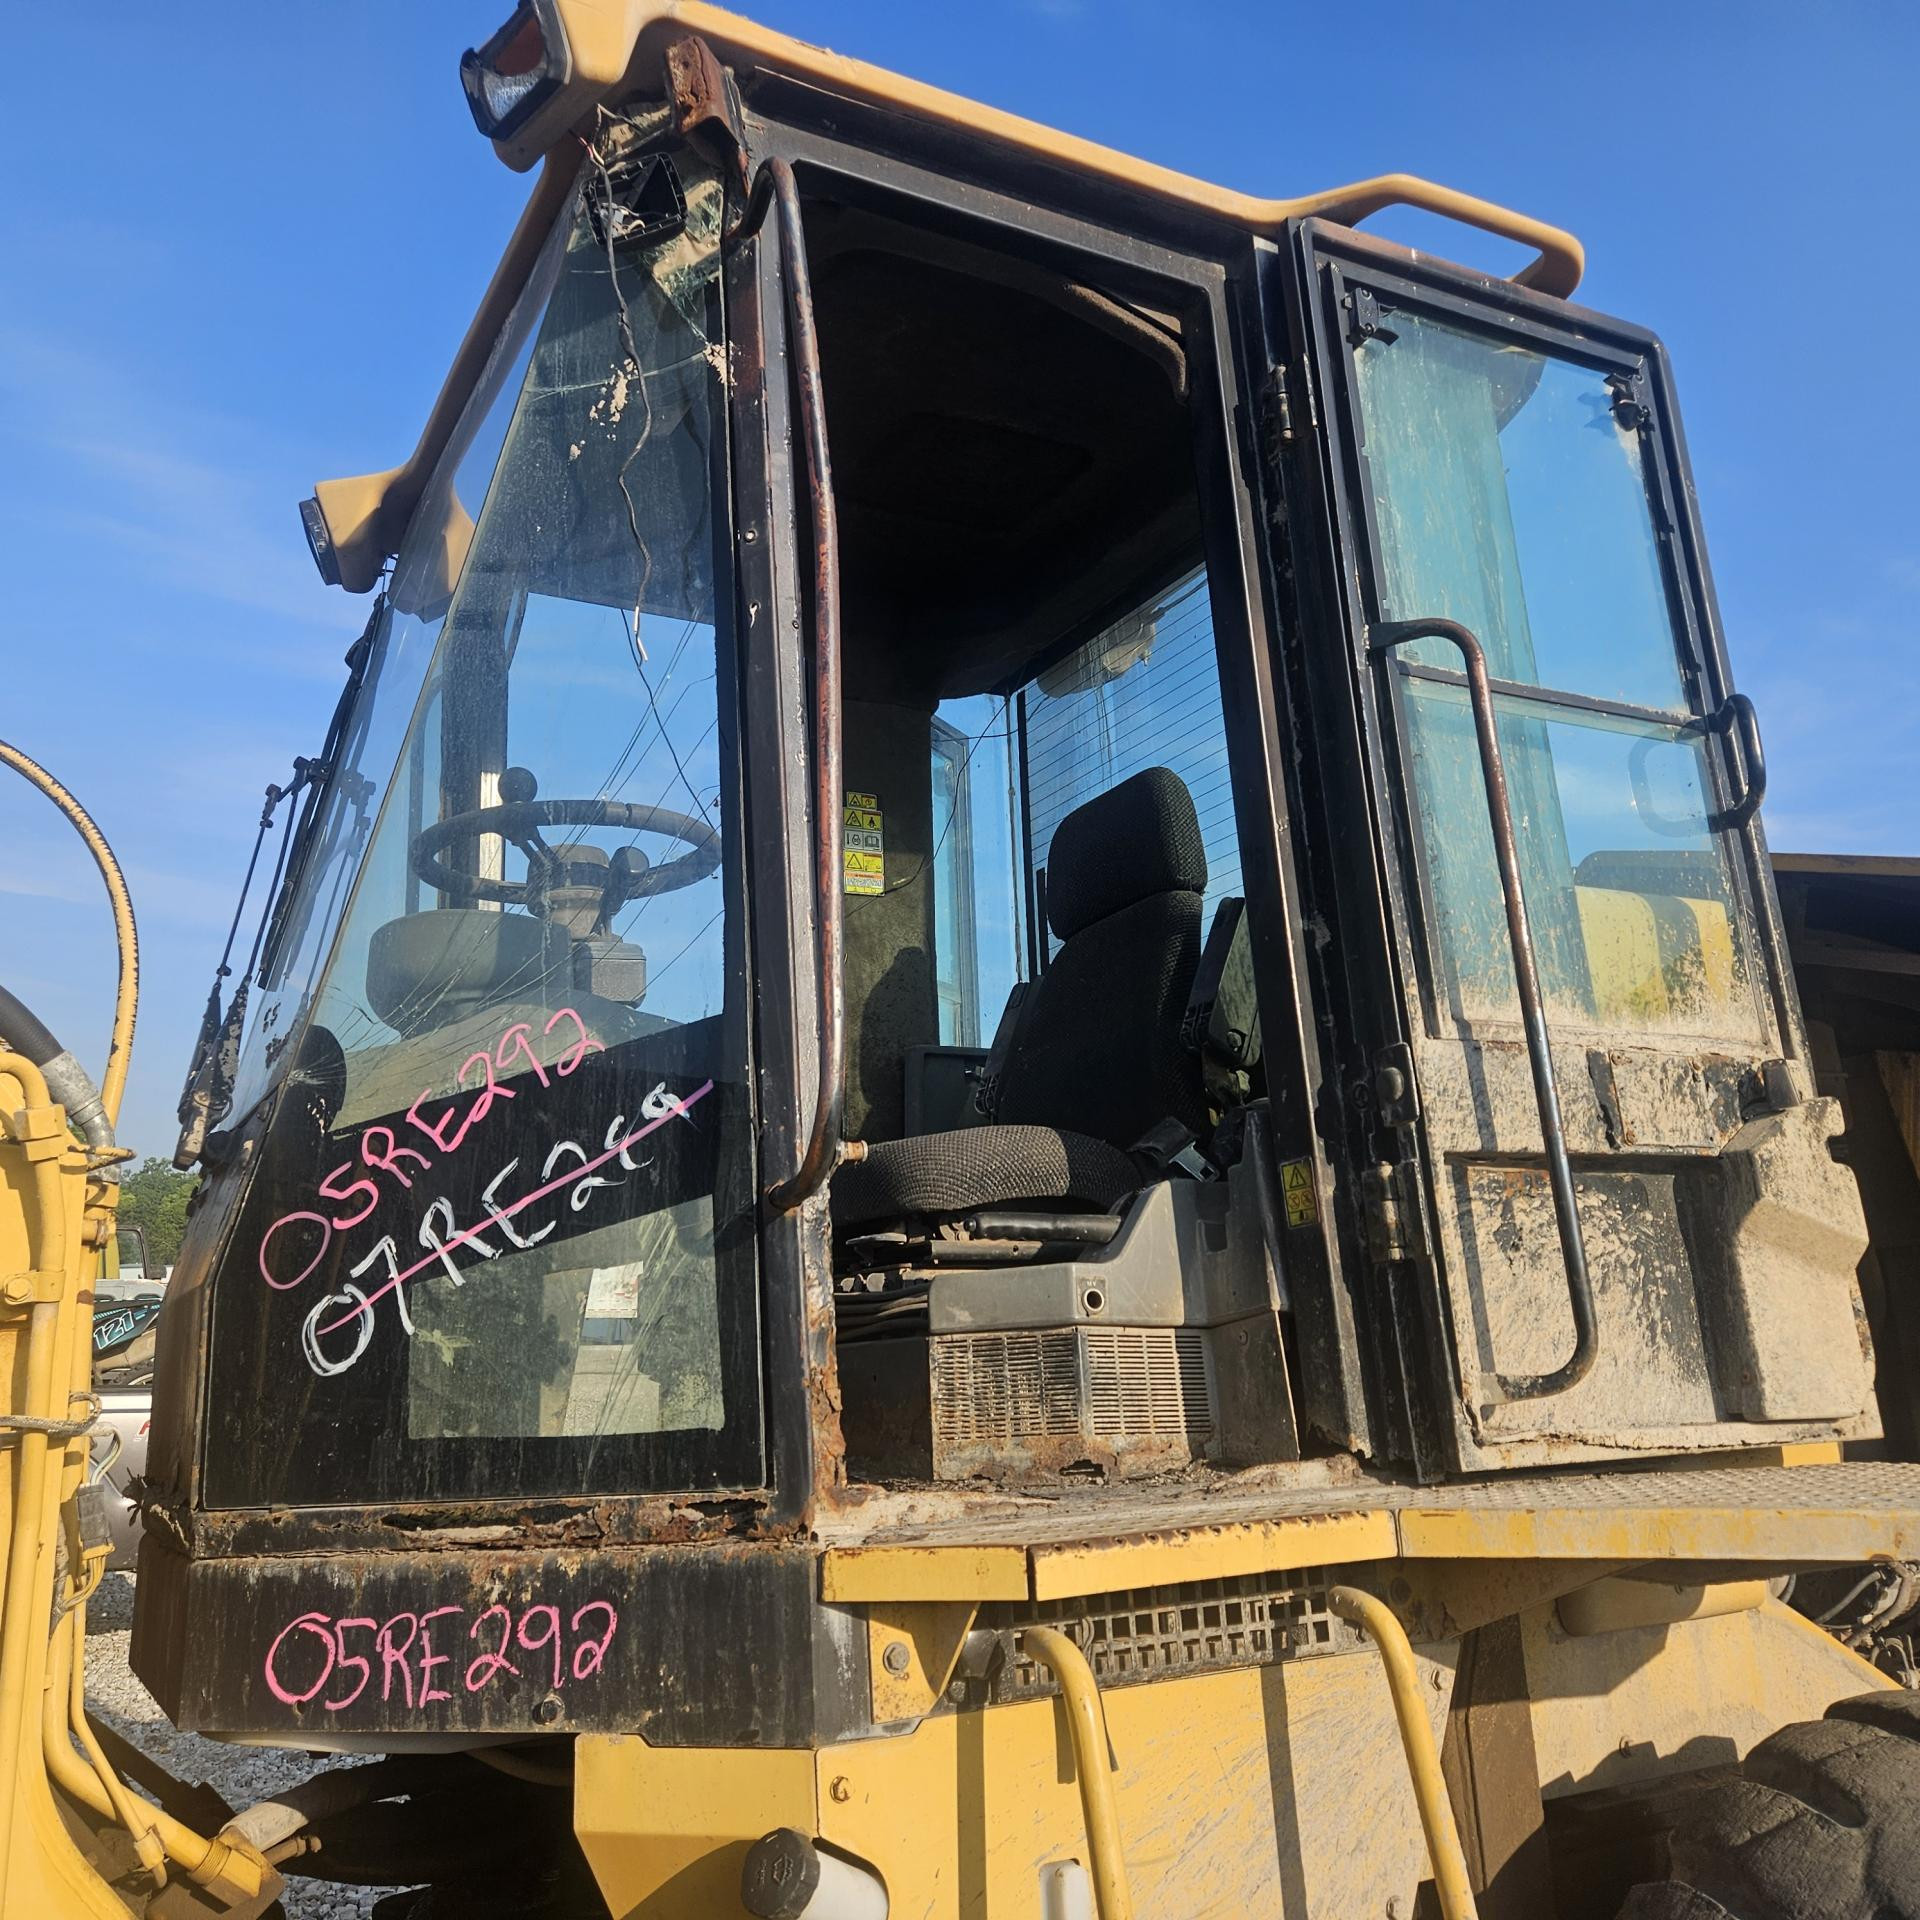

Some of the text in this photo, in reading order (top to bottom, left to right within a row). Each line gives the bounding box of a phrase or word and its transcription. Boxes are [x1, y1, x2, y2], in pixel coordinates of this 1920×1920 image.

[260, 1007, 606, 1290] 05RE292
[93, 1311, 135, 1350] 121
[264, 1601, 618, 1711] 05RE292
